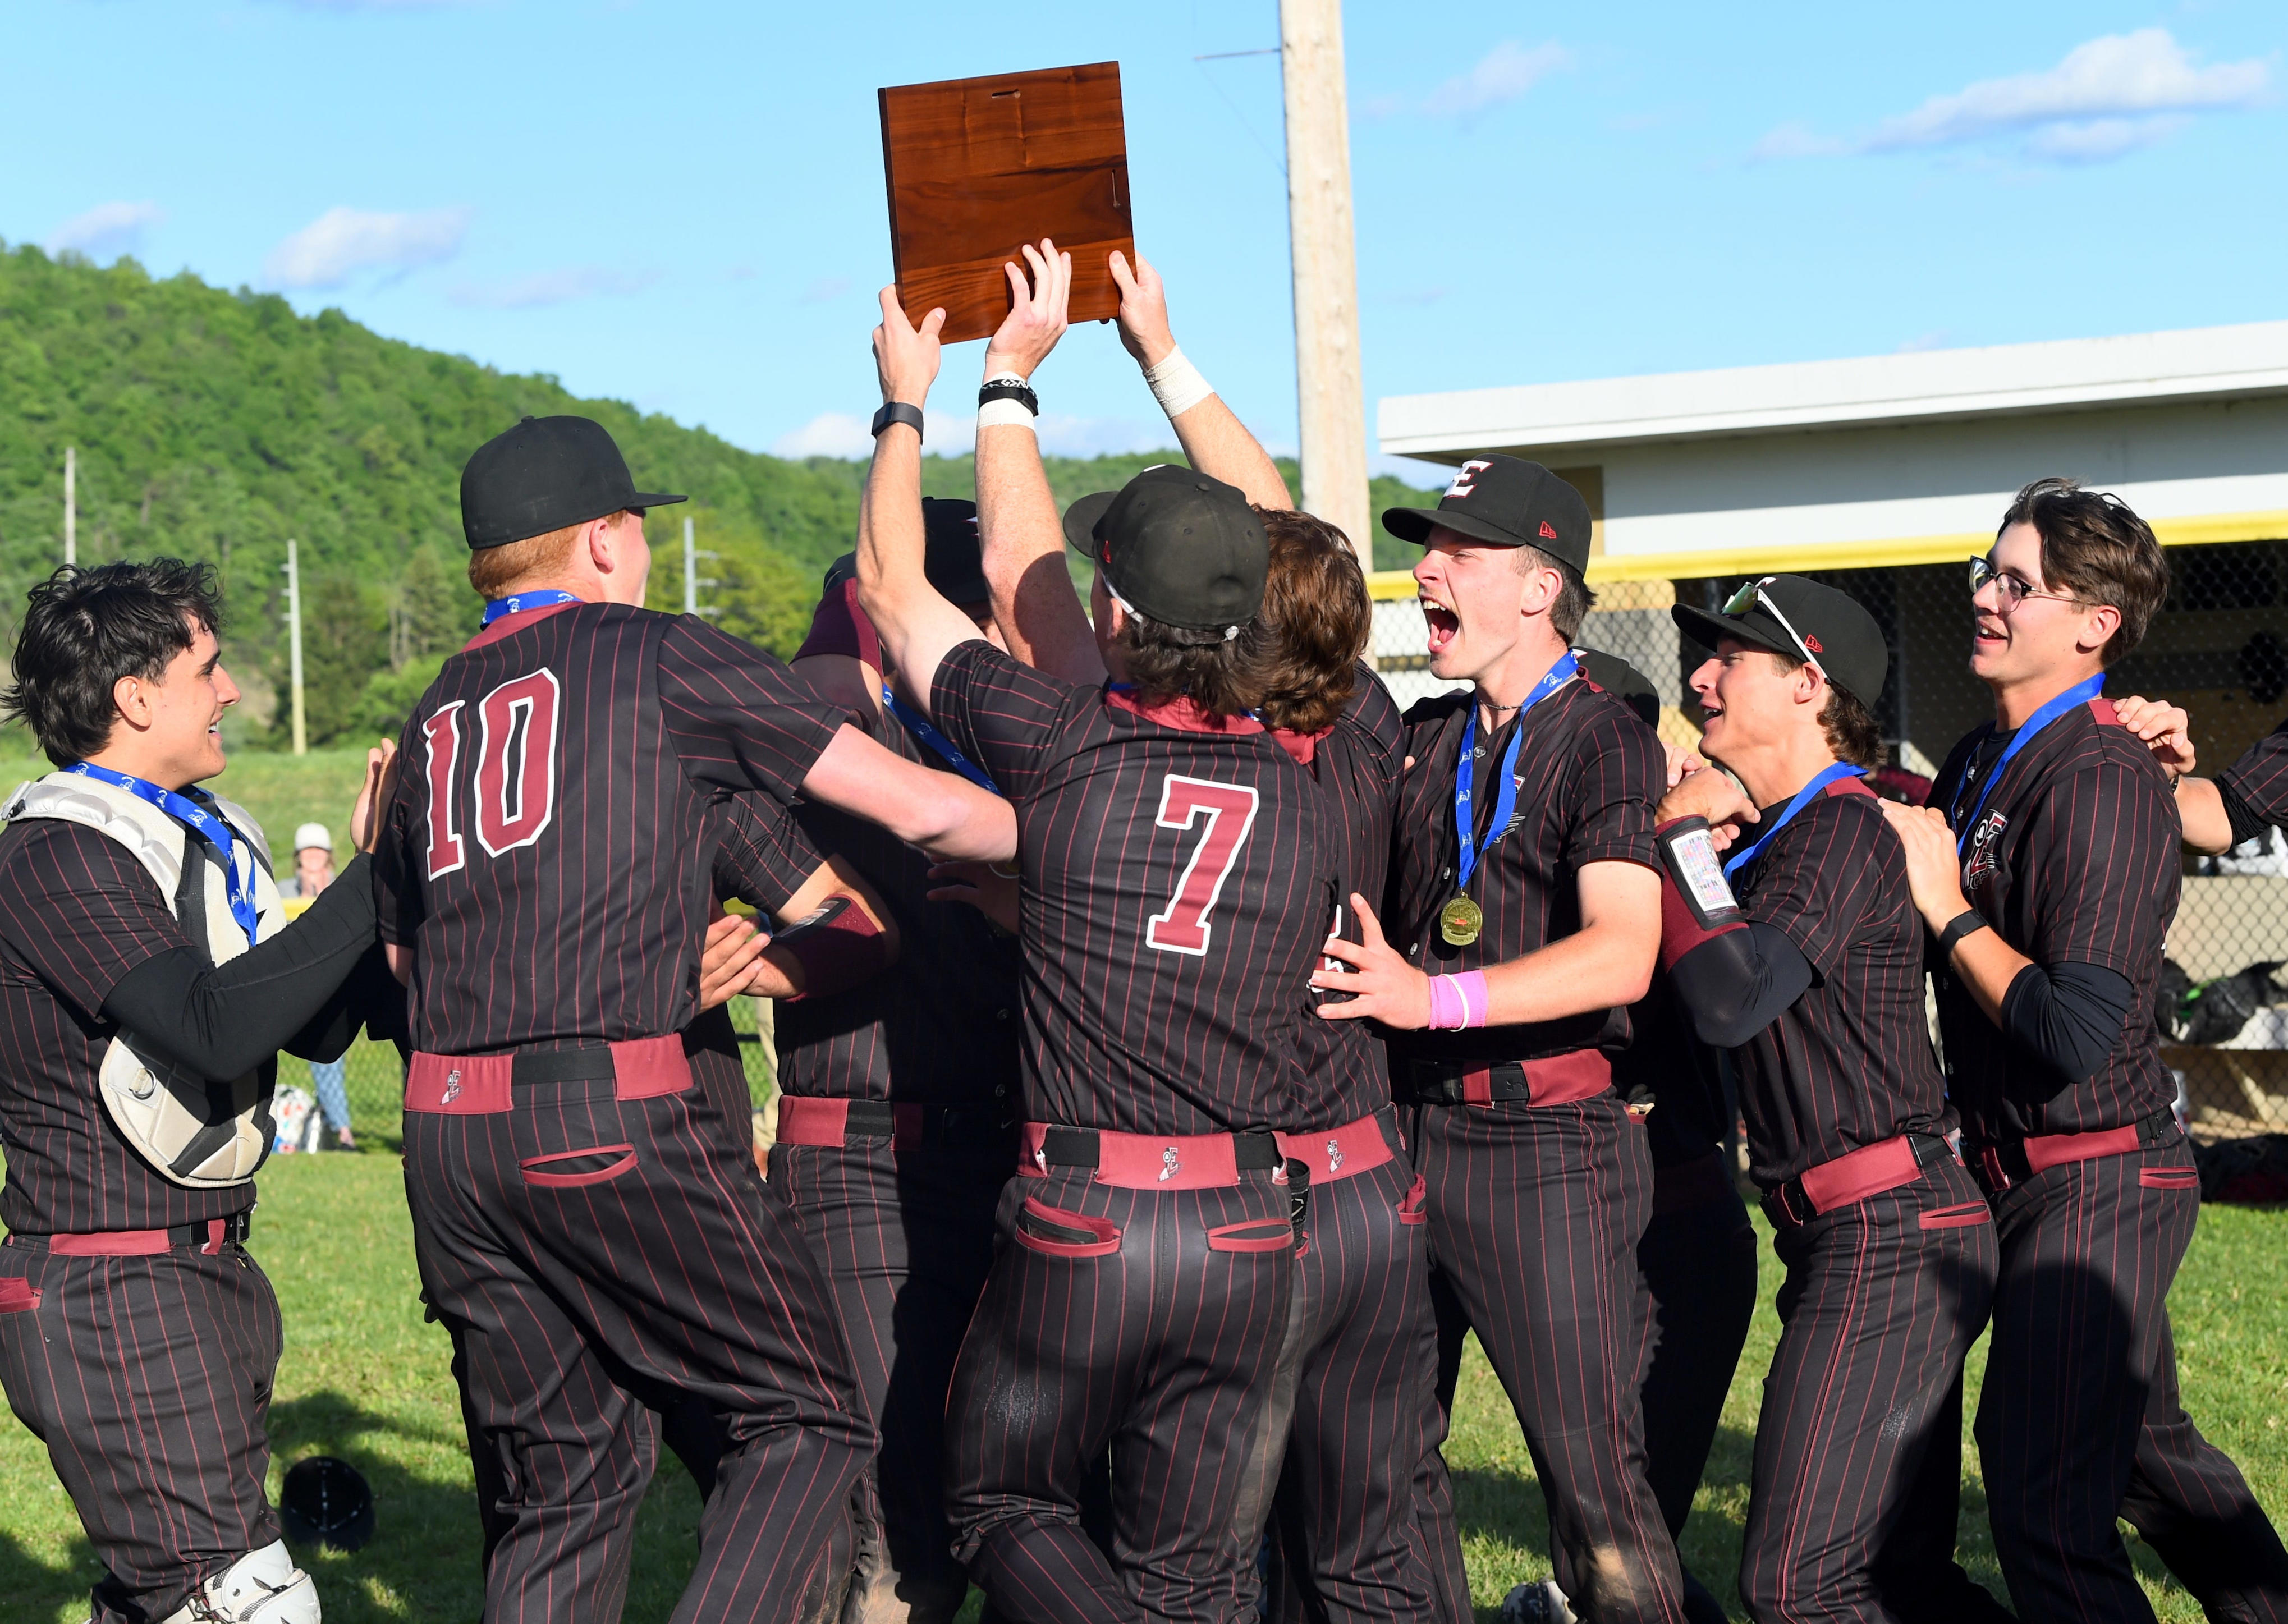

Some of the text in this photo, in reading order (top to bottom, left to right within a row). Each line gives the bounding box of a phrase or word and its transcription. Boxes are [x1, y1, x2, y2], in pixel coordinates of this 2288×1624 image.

[1443, 460, 1493, 498] E
[422, 667, 560, 882] 10
[1145, 773, 1259, 956] 7
